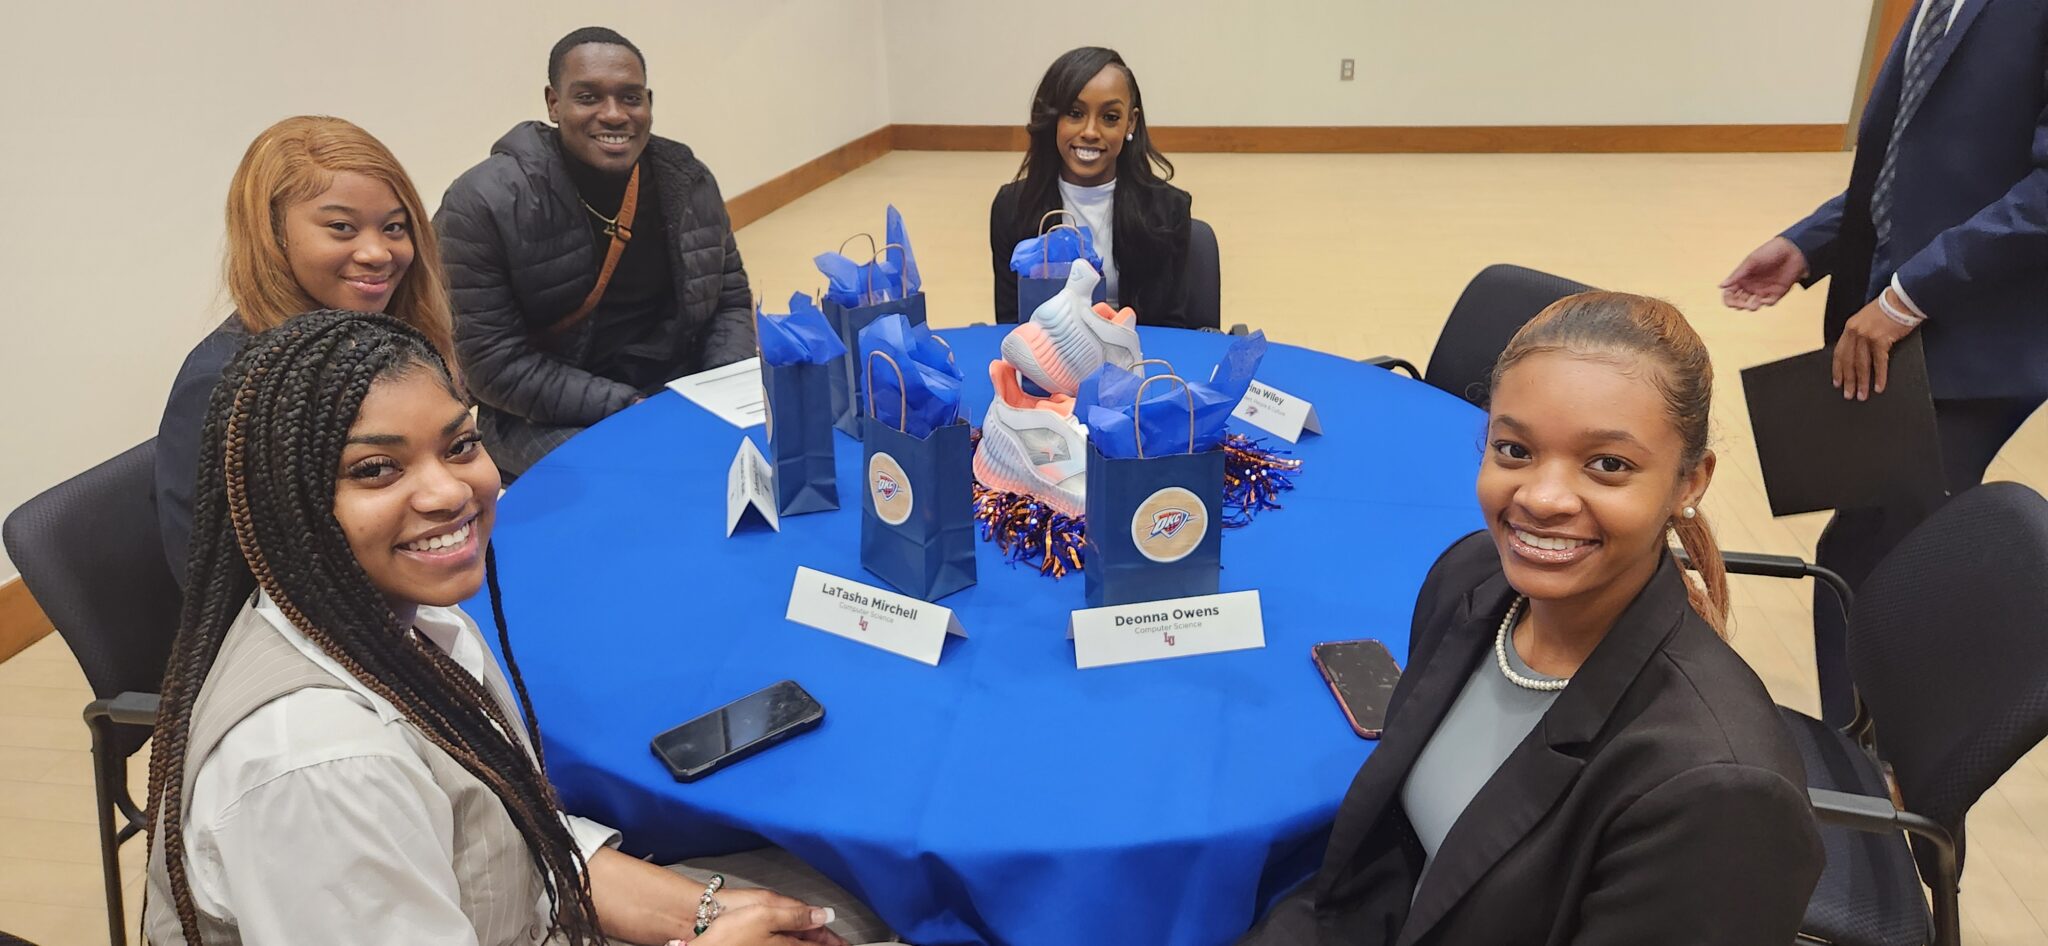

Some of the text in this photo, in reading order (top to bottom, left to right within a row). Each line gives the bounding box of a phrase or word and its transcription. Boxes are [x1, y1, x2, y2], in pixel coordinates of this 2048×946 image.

[1263, 389, 1284, 405] Wiley
[1151, 513, 1181, 535] OKC
[822, 583, 918, 620] LaTasha Mirchell
[839, 602, 894, 623] Computer Science
[1115, 606, 1220, 626] Deonna Owens
[1134, 621, 1202, 635] Computer Science
